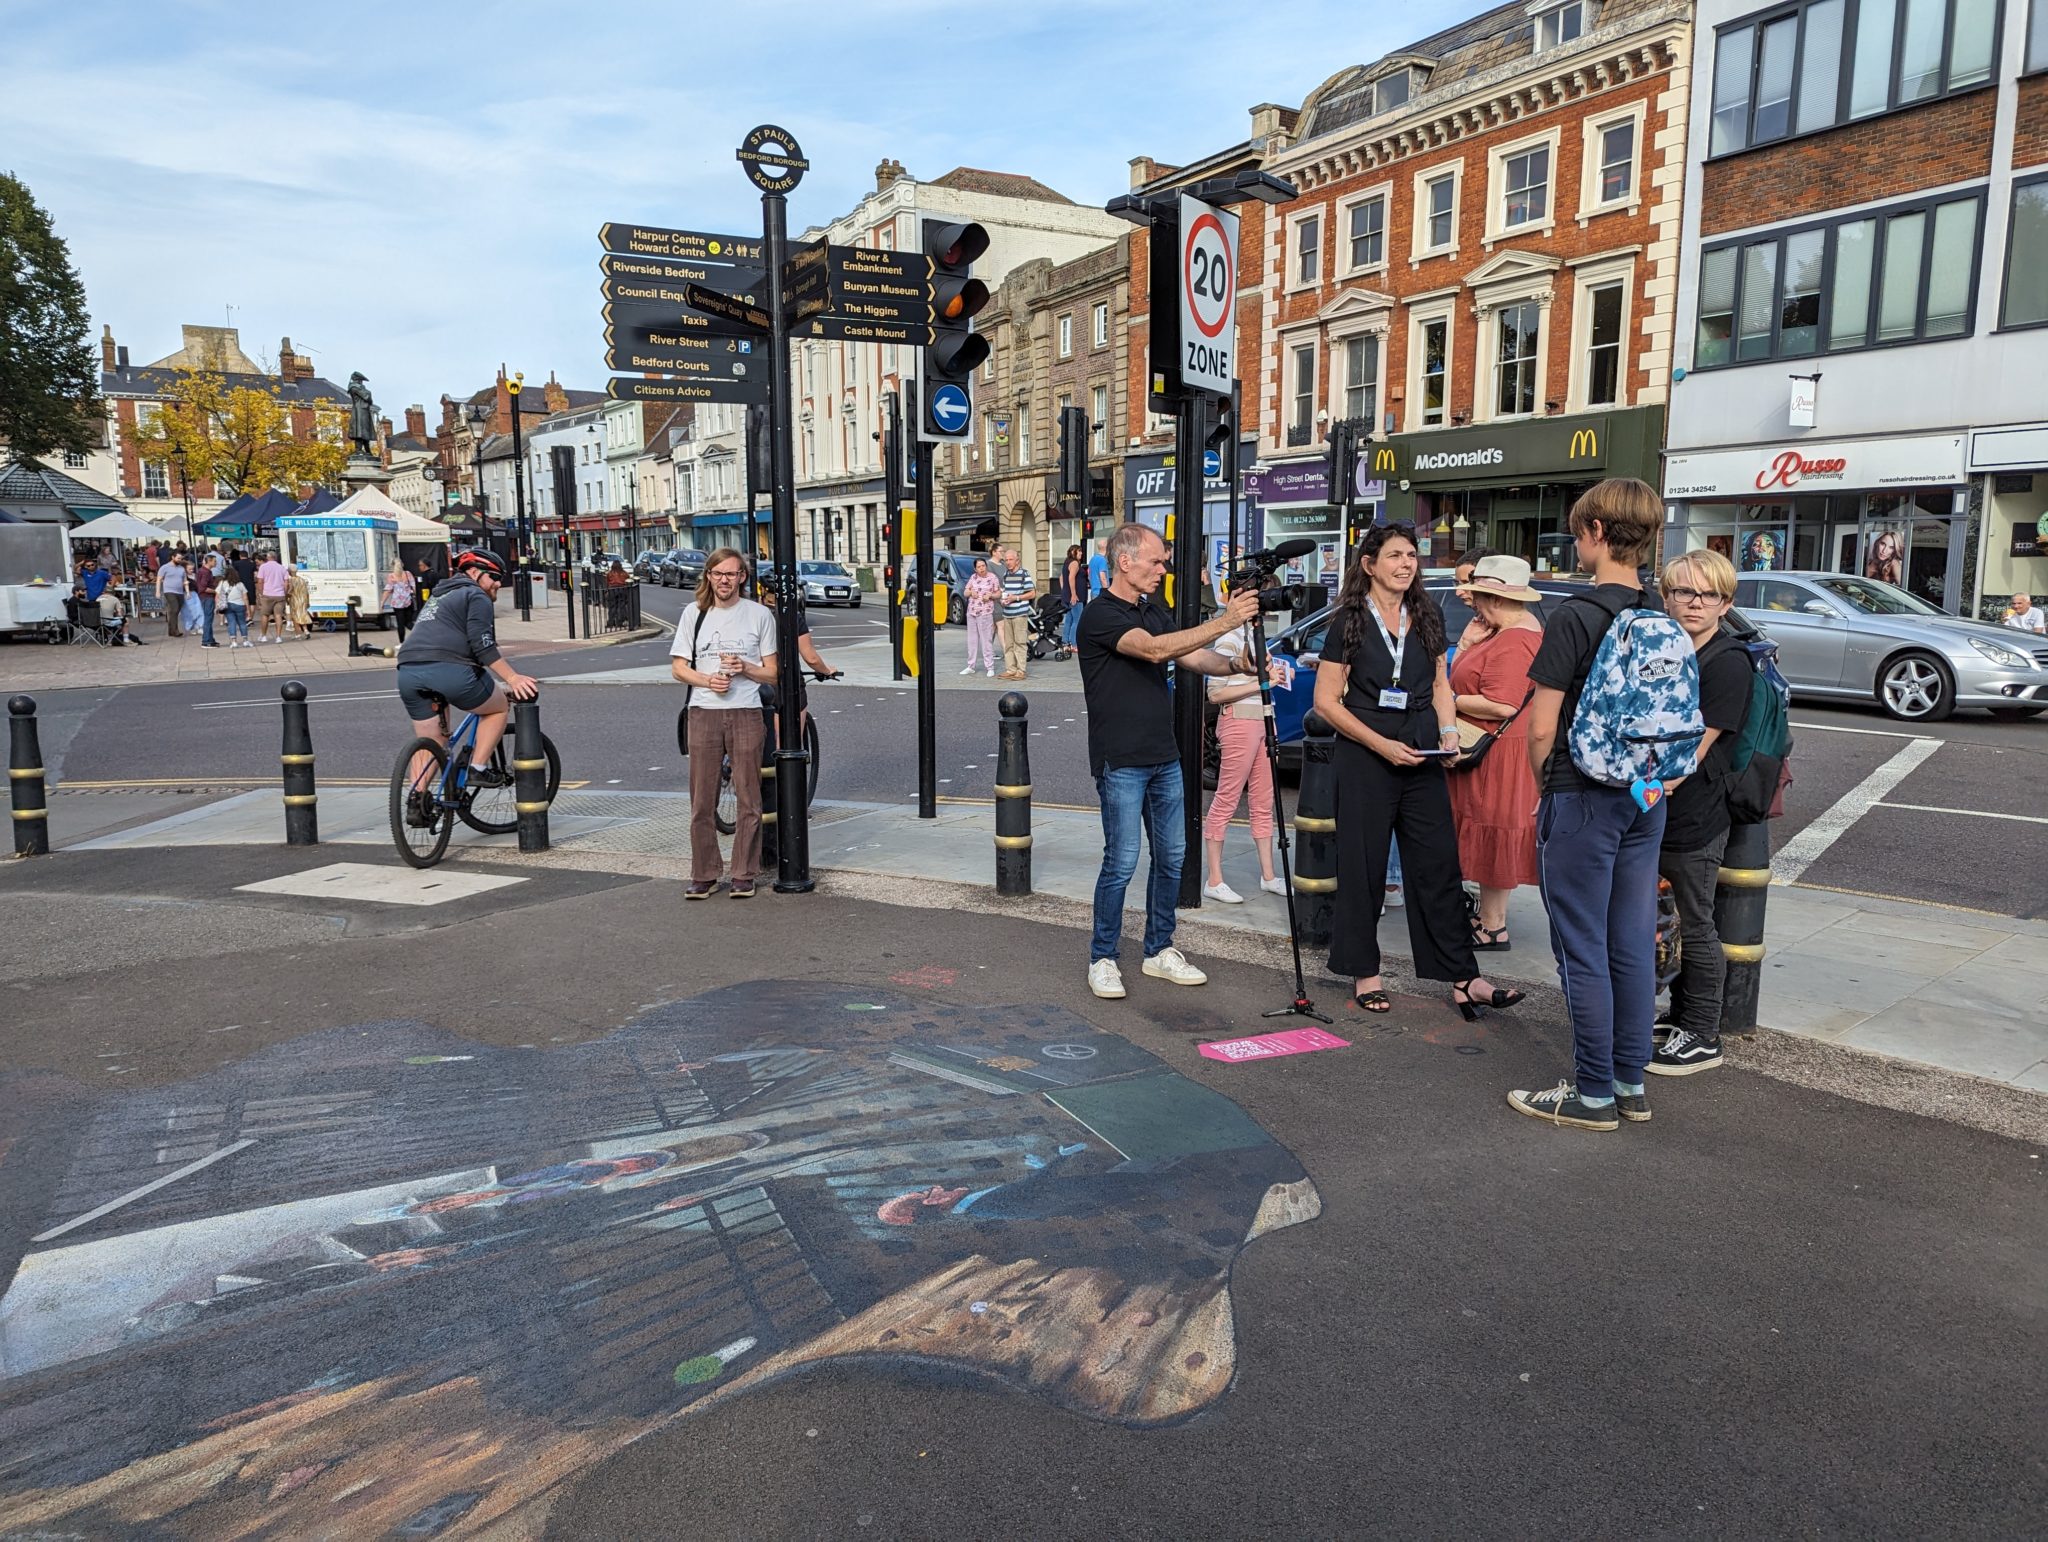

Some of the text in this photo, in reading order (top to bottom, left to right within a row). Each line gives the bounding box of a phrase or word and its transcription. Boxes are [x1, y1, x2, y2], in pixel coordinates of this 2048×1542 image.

[751, 129, 795, 151] ST PAULS
[738, 151, 808, 168] BEDFORD BOROUGH
[754, 172, 794, 190] SQUARE
[633, 229, 706, 246] Harpur Centre
[630, 240, 706, 258] Howard Centre
[855, 251, 889, 263] River &
[612, 262, 706, 280] Riverside Bedford
[842, 260, 903, 275] Embankment
[1193, 246, 1226, 302] 20
[617, 285, 657, 299] Council
[843, 281, 919, 296] Bunyan Museum
[728, 304, 743, 319] Quay
[844, 303, 899, 317] The Higgins
[681, 314, 708, 327] Taxis
[844, 325, 906, 338] Castle Mound
[649, 334, 709, 348] River Street
[632, 356, 710, 371] Bedford Courts
[1187, 341, 1228, 379] ZONE
[633, 384, 711, 397] Citizens Advice
[1954, 439, 1961, 448] 7
[1163, 456, 1176, 467] HIG
[1414, 448, 1504, 471] McDonald's
[1755, 451, 1847, 490] Russo
[1800, 472, 1845, 481] Hairdressing
[1879, 473, 1957, 483] russohairdressing.co.uk
[1136, 471, 1166, 495] OFF
[1273, 476, 1286, 486] High
[1287, 474, 1304, 483] Street
[1669, 485, 1717, 495] 01234 342542
